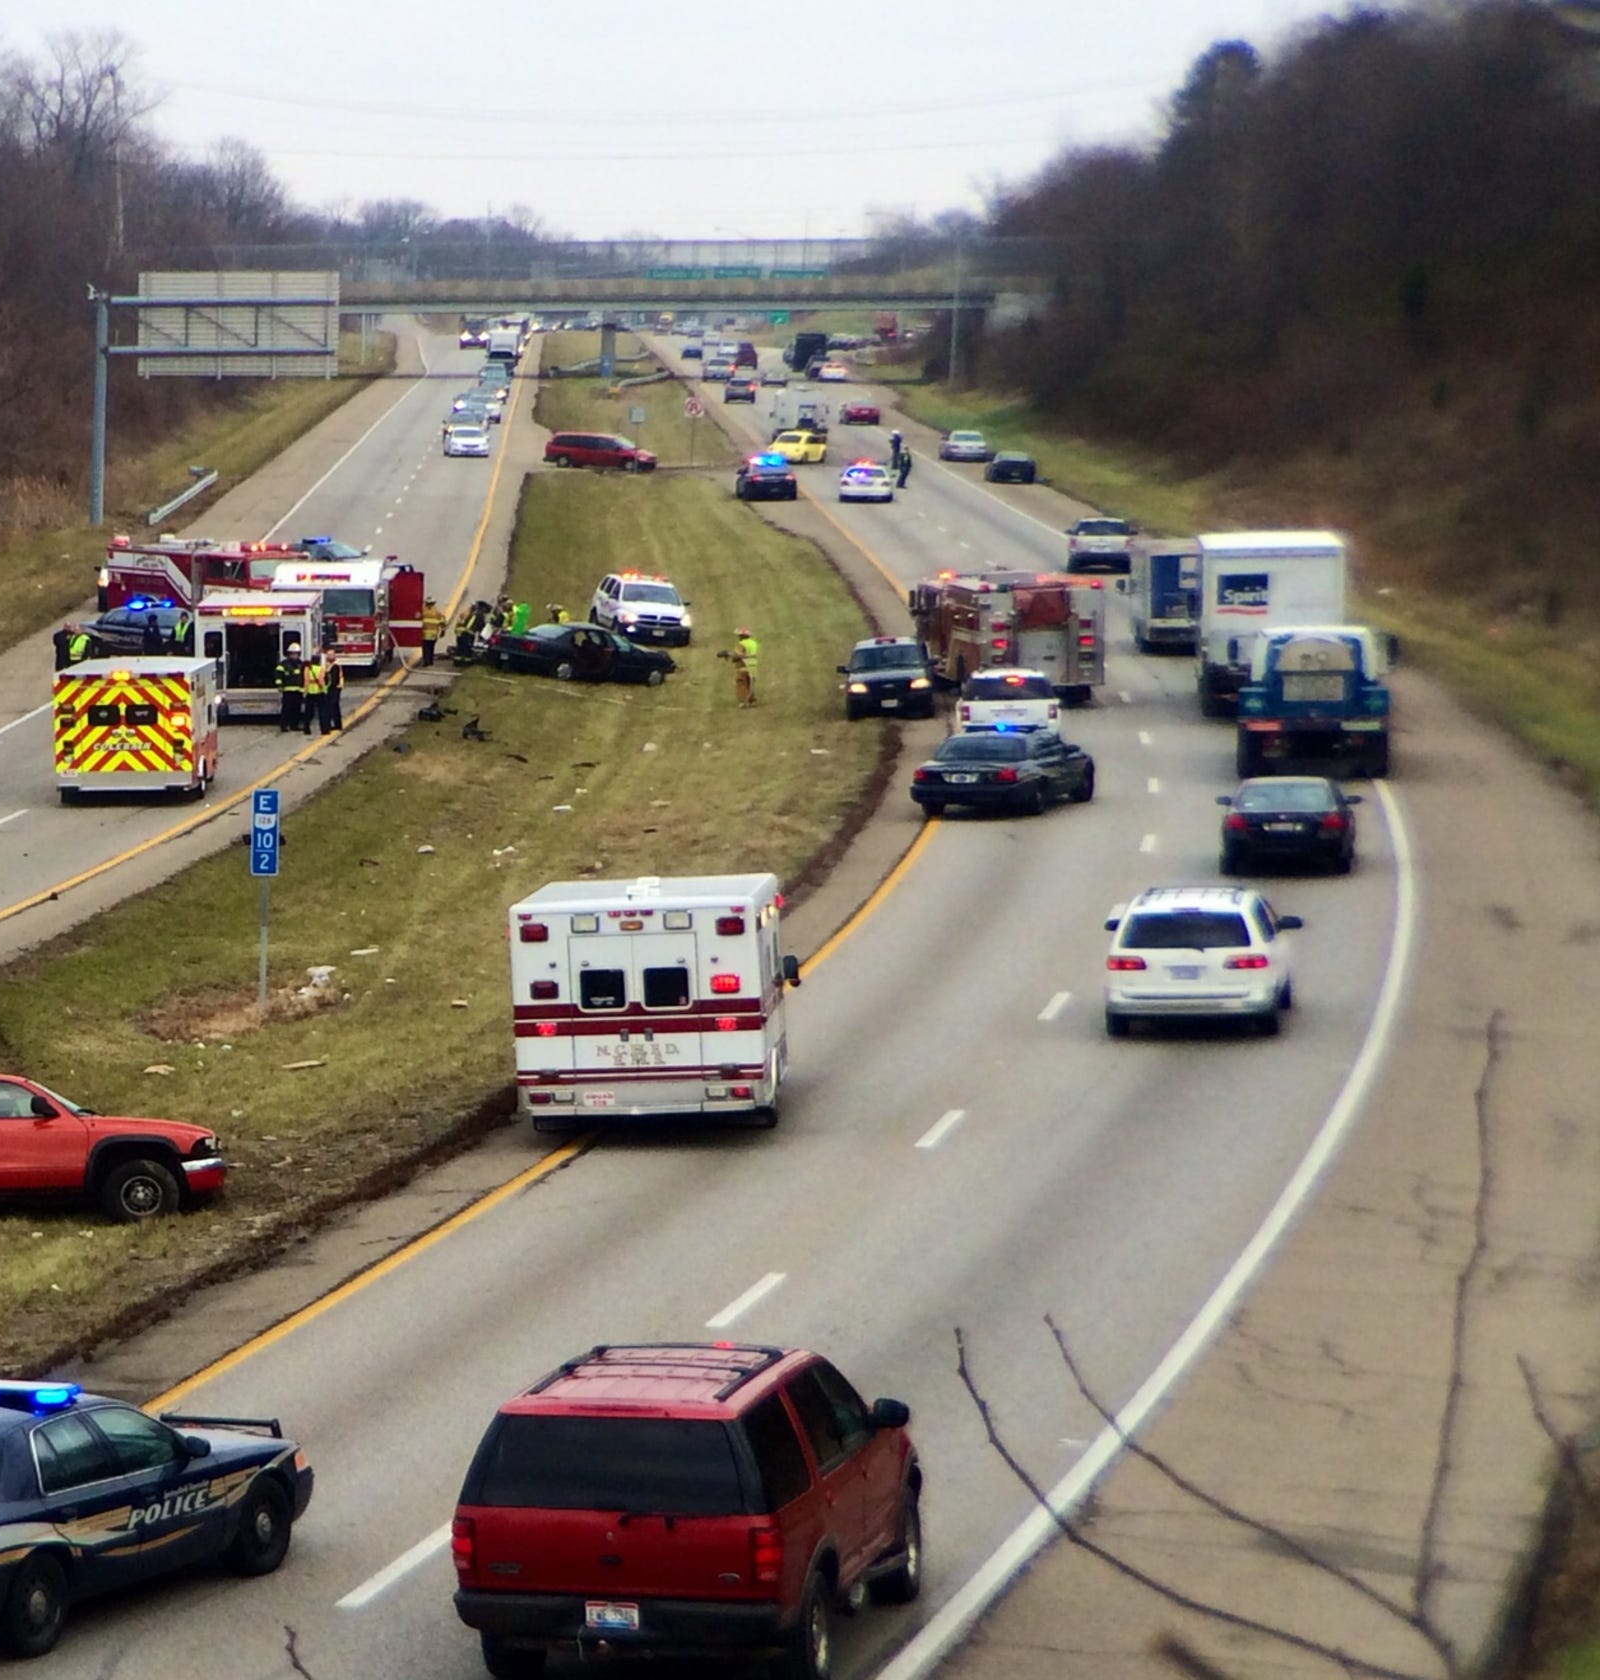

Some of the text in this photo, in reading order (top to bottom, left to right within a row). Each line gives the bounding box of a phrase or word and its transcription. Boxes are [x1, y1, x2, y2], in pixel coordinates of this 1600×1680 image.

[259, 795, 272, 811] E
[257, 832, 274, 848] 10
[259, 853, 270, 870] 2
[128, 1488, 208, 1529] POLICE
